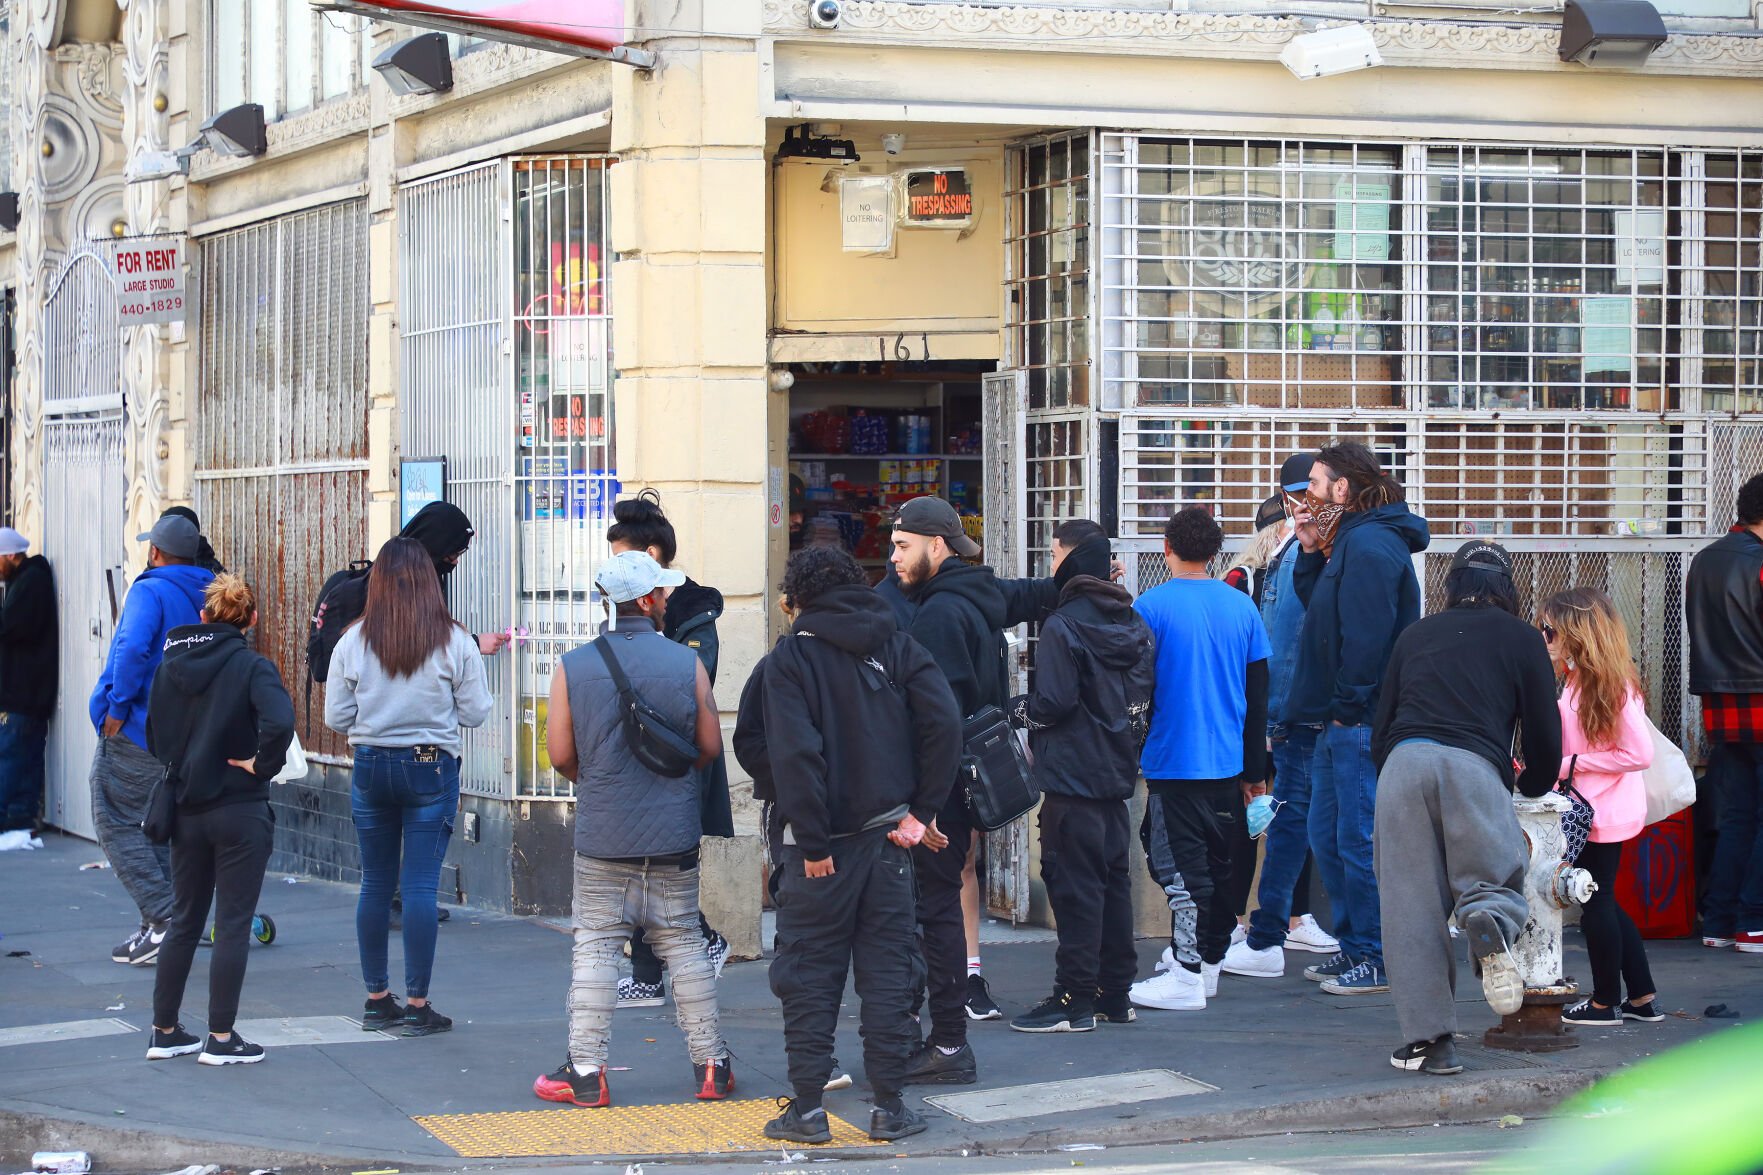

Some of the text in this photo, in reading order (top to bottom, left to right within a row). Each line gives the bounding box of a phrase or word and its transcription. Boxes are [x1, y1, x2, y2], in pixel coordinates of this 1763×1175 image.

[934, 174, 948, 193] NO
[911, 194, 971, 215] TRESPASSING
[117, 249, 176, 274] FOR RENT
[1623, 248, 1661, 257] LOERING
[124, 278, 175, 292] LARGE STUDIO
[121, 297, 182, 315] 440-1829
[879, 331, 930, 361] 161
[546, 416, 604, 437] RESASING
[573, 473, 614, 500] EB
